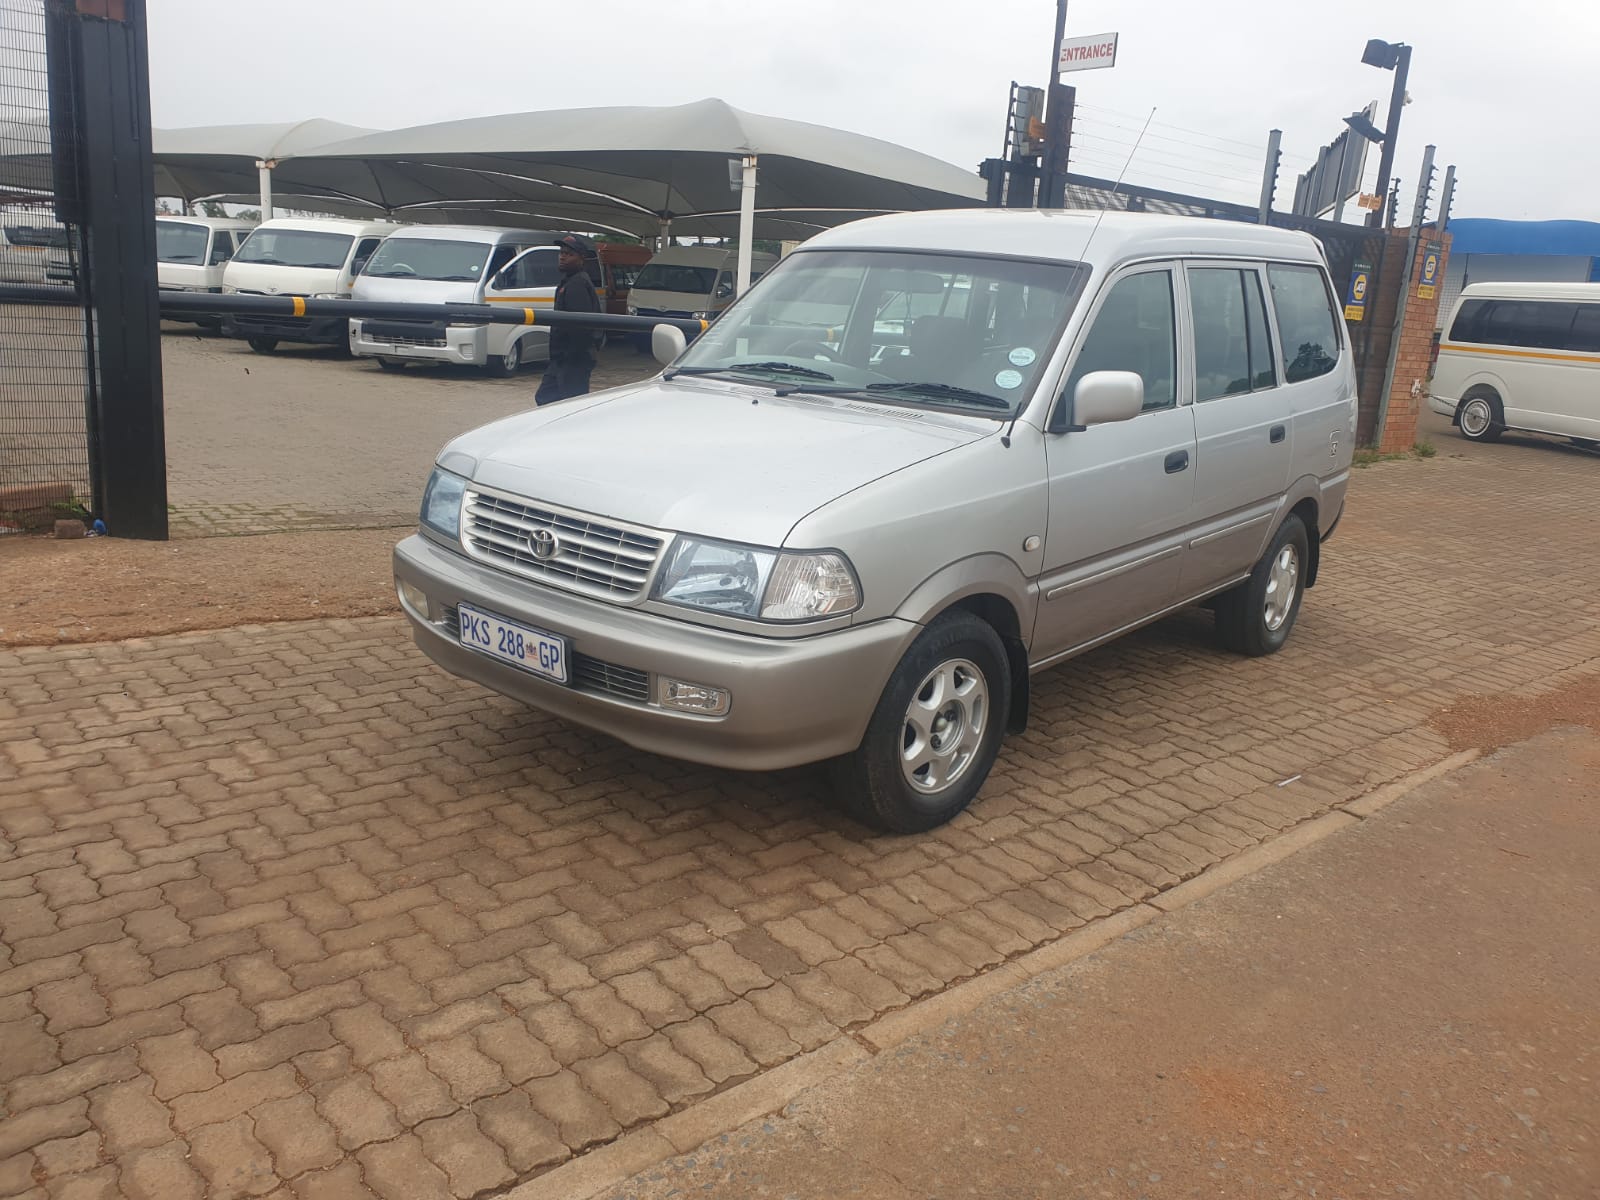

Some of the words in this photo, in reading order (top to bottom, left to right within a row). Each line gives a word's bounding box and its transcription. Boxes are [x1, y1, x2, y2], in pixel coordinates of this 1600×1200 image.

[1060, 43, 1113, 62] ENTRANCE
[460, 612, 491, 646] PKS
[497, 626, 525, 660] 288
[539, 641, 559, 672] GP
